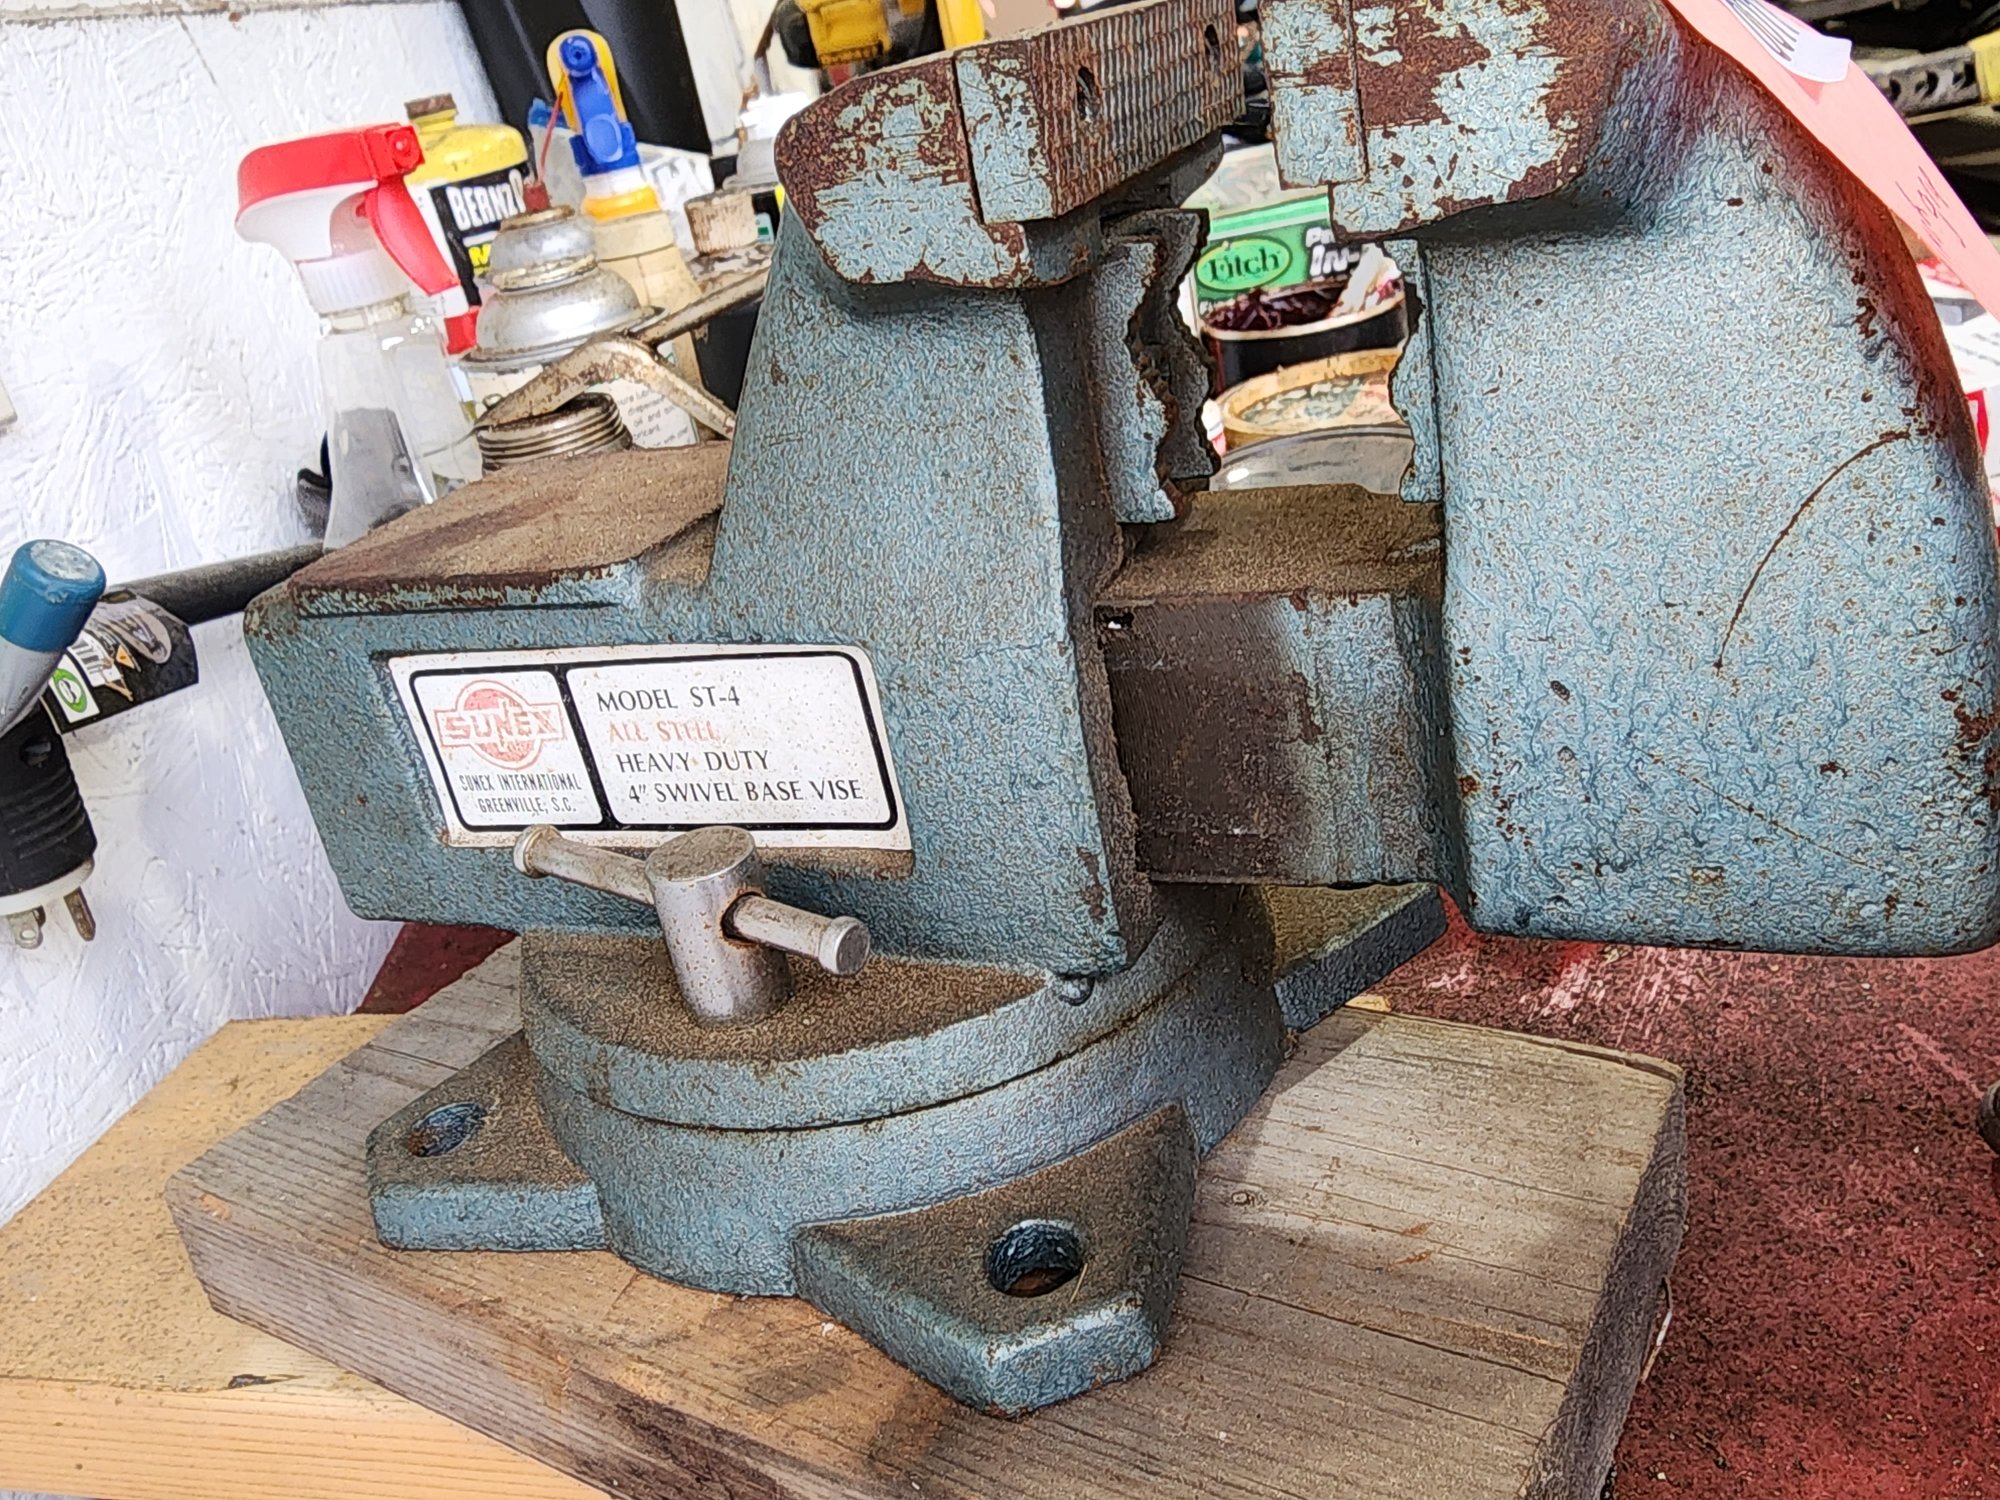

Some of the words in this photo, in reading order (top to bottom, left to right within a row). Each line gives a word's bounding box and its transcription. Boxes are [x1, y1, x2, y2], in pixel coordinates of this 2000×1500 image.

[1208, 246, 1281, 282] Fitch
[596, 688, 679, 712] MODEL
[689, 686, 740, 709] ST-4
[445, 699, 558, 753] SUNEX
[608, 720, 649, 743] ALL
[615, 751, 690, 774] HEAVY
[703, 749, 769, 772] DUTY
[459, 773, 495, 792] SUNEX
[497, 772, 582, 792] INTERNATIONAL
[654, 782, 739, 803] SWIVEL
[744, 780, 804, 801] BASE
[808, 778, 864, 801] VISE
[477, 796, 549, 815] GREENVILLE,
[550, 796, 578, 813] S.C.
